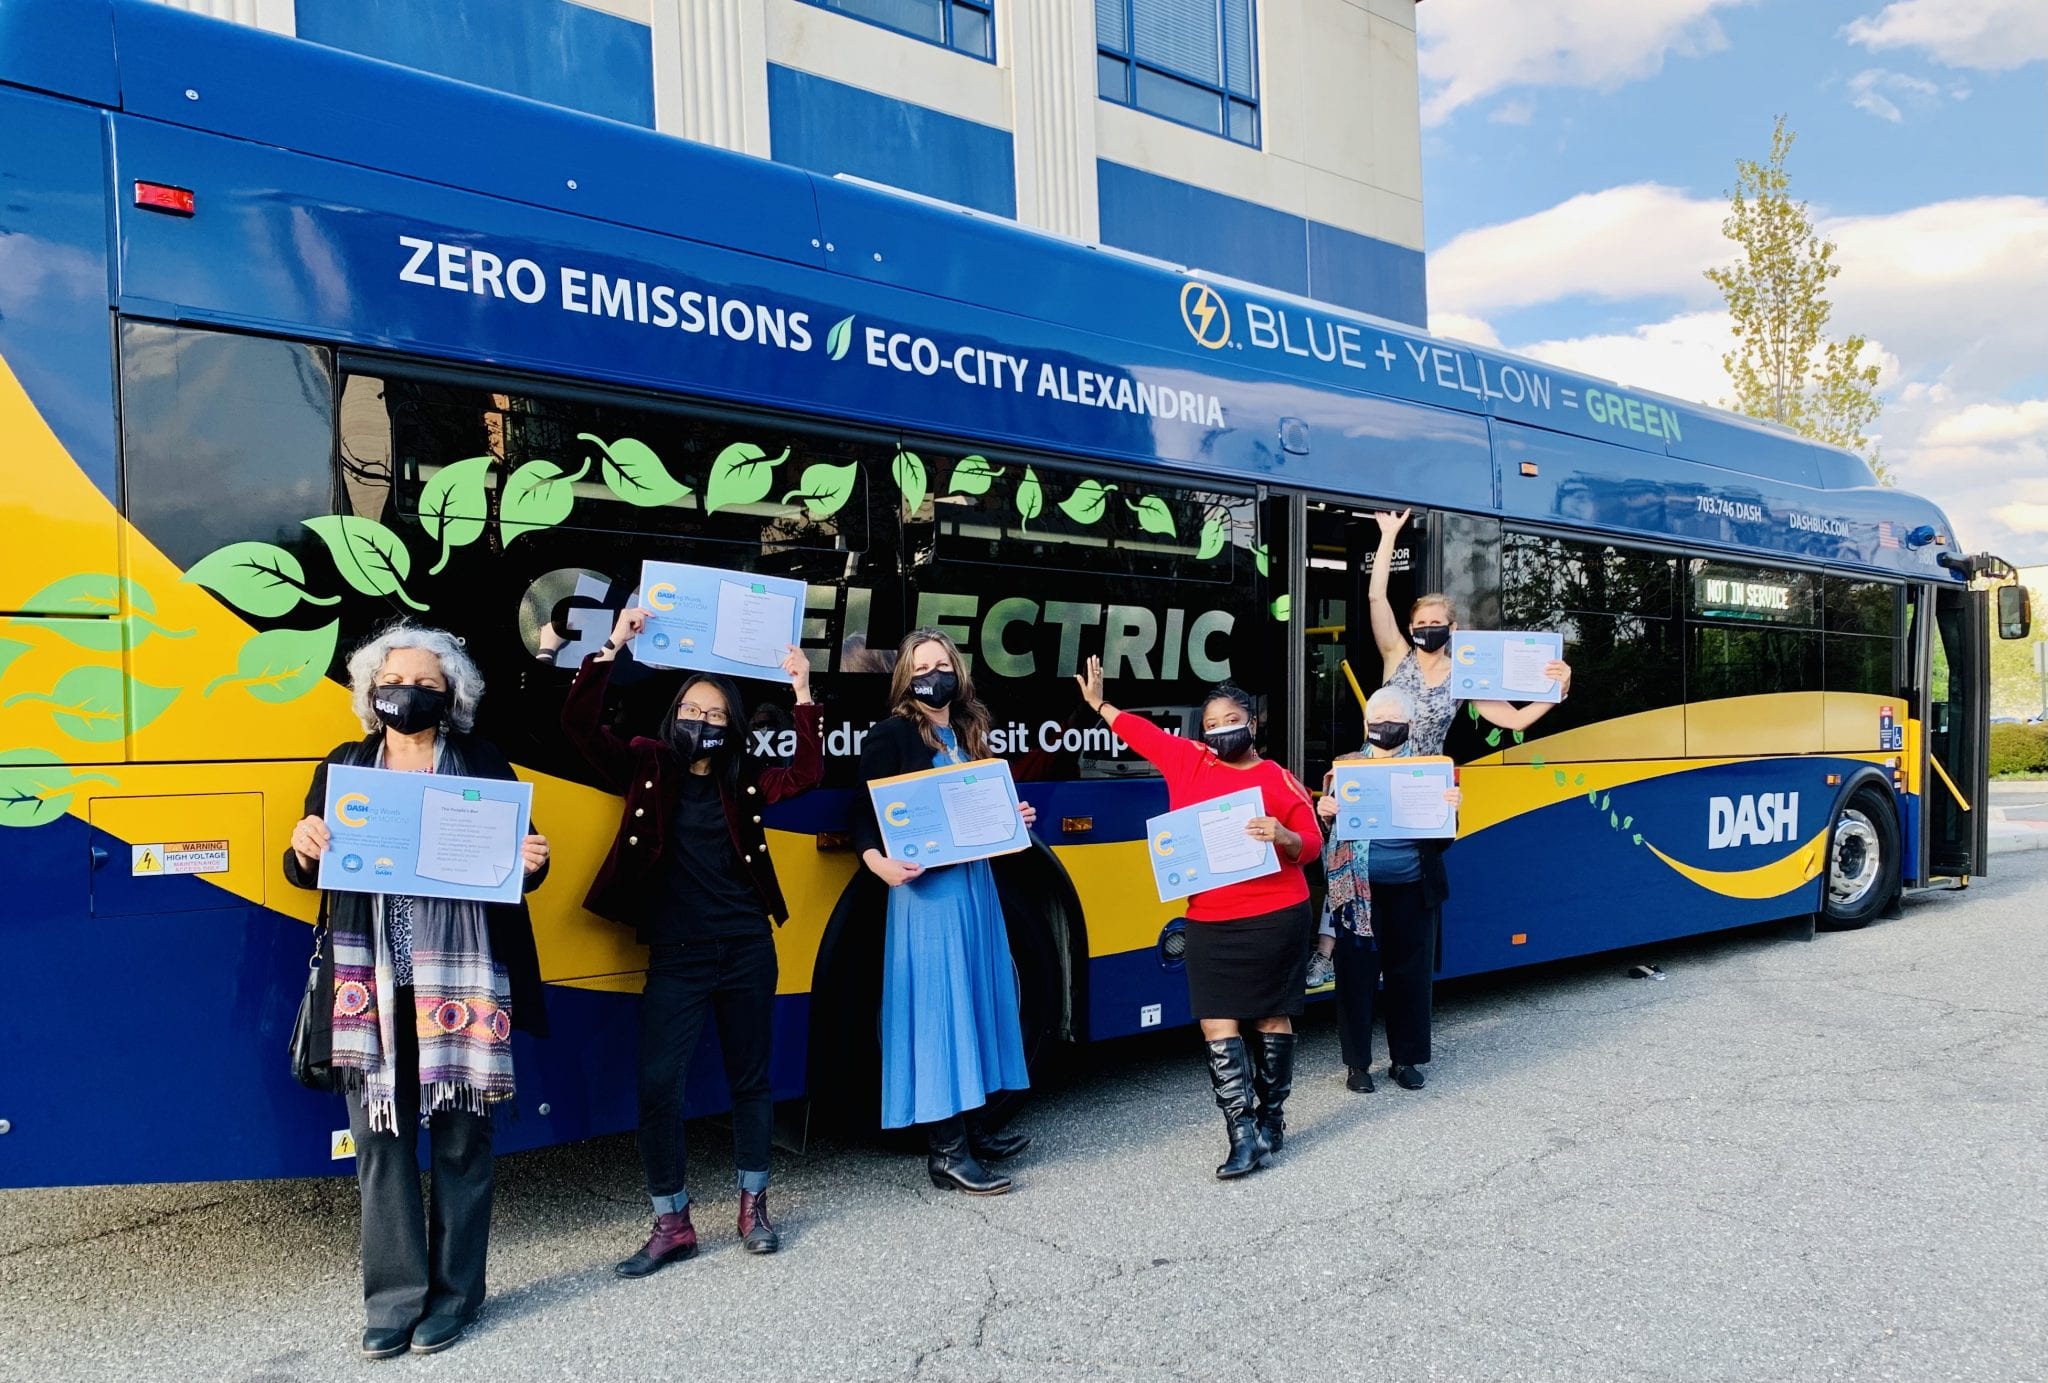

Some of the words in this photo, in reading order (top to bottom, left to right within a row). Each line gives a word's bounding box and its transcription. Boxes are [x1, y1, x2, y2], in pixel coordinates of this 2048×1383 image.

[399, 236, 546, 303] ZERO
[560, 267, 813, 351] EMISSIONS
[865, 326, 1028, 392] ECO-CITY
[1036, 363, 1225, 428] ALEXANDRIA
[1246, 303, 1366, 370] BLUE
[1404, 341, 1551, 411] YELLOW
[1585, 389, 1682, 442] GREEN
[1697, 495, 1734, 517] 703.746
[1735, 502, 1761, 522] DASH
[1789, 512, 1850, 538] DASHBUS.COM
[1706, 579, 1728, 603] NOT
[1731, 581, 1744, 605] IN
[1747, 583, 1789, 610] SERVICE
[375, 699, 398, 715] DASH
[1708, 791, 1799, 850] DASH
[166, 852, 187, 861] HIGH
[190, 851, 226, 860] VOLTAGE
[182, 842, 223, 851] WARNING
